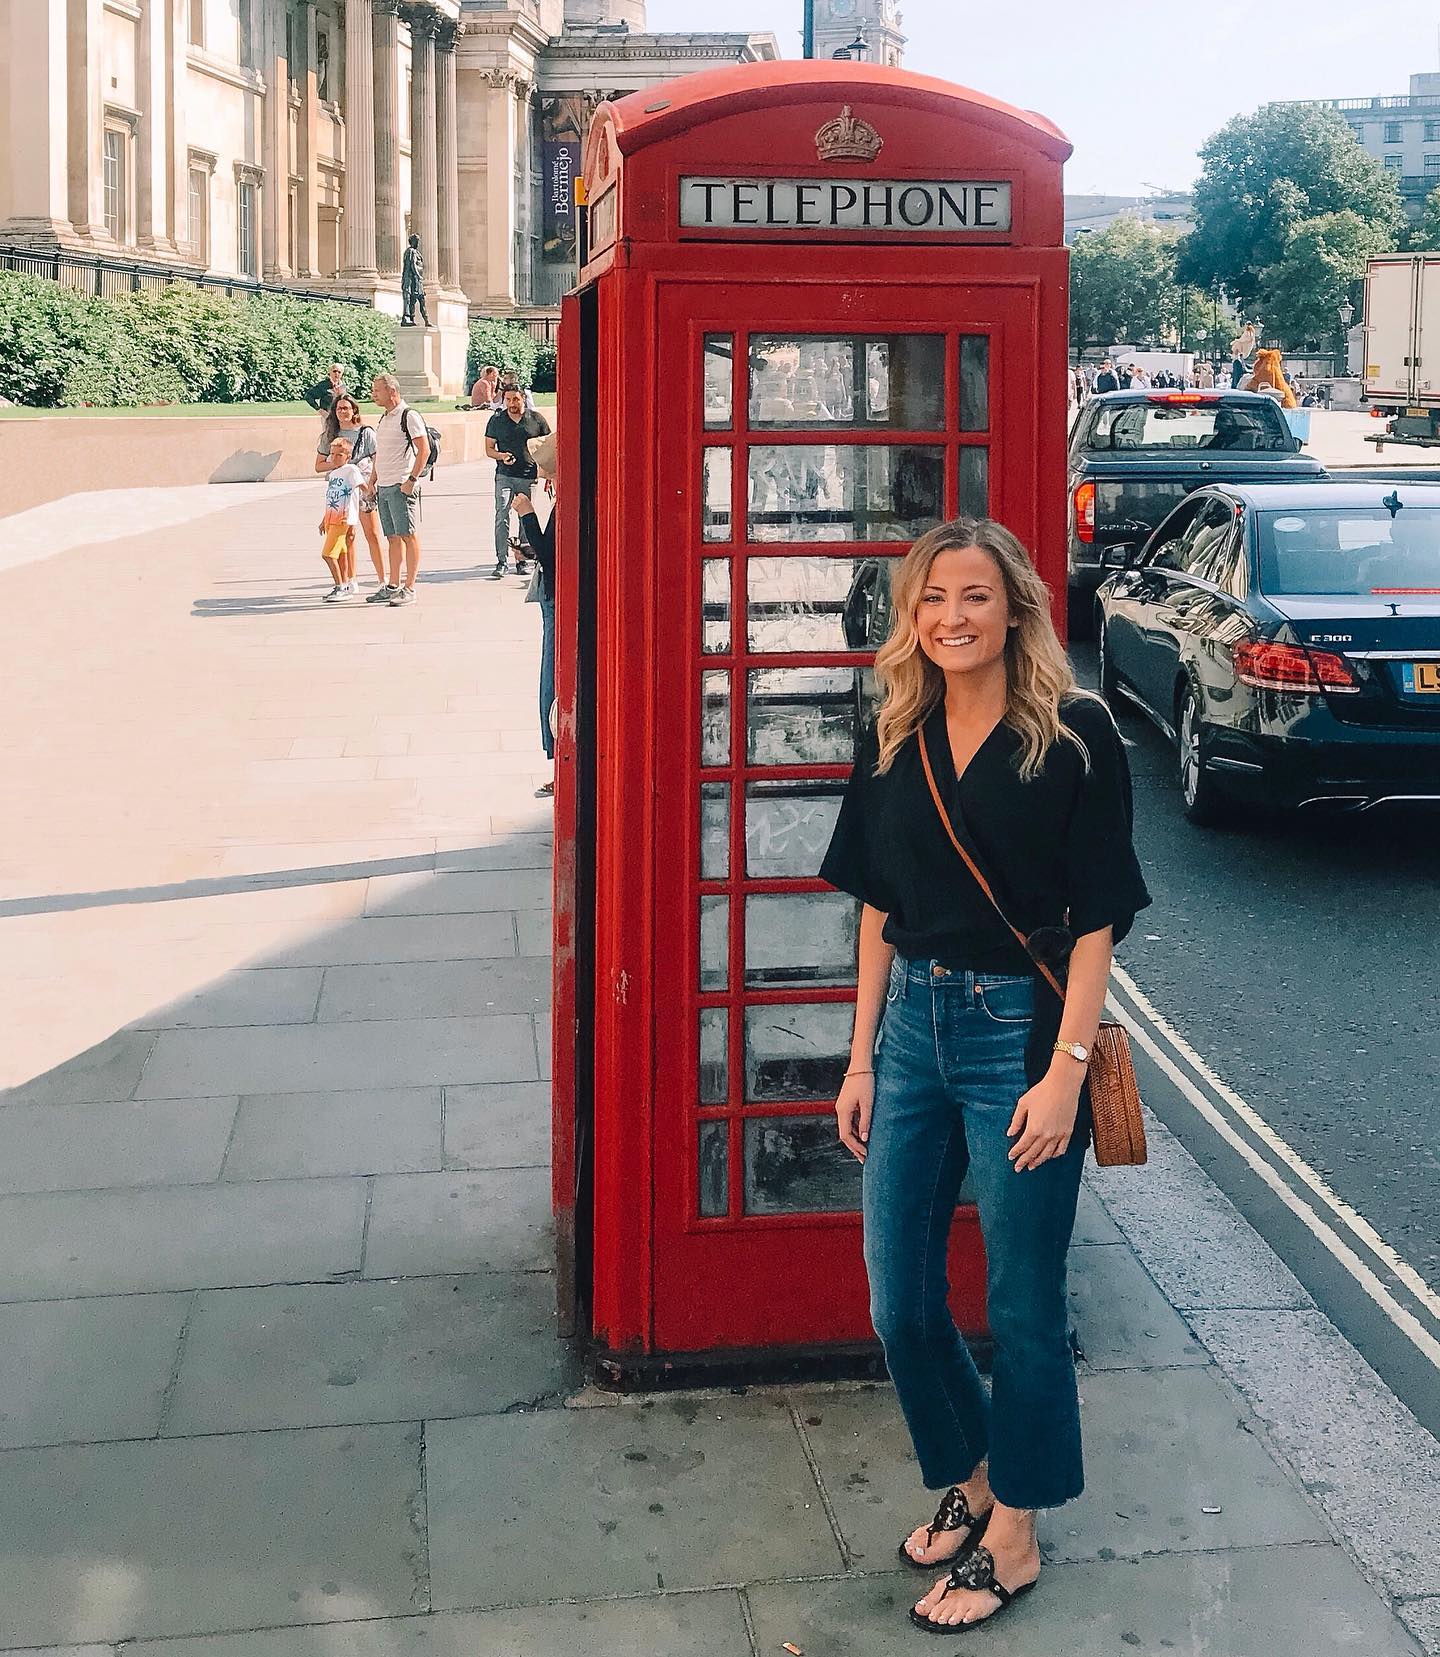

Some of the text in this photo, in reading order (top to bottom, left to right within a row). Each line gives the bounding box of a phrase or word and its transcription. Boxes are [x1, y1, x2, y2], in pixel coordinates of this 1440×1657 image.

[555, 147, 573, 215] Bermejo
[690, 183, 999, 227] TELEPHONE
[1311, 634, 1352, 642] E 300
